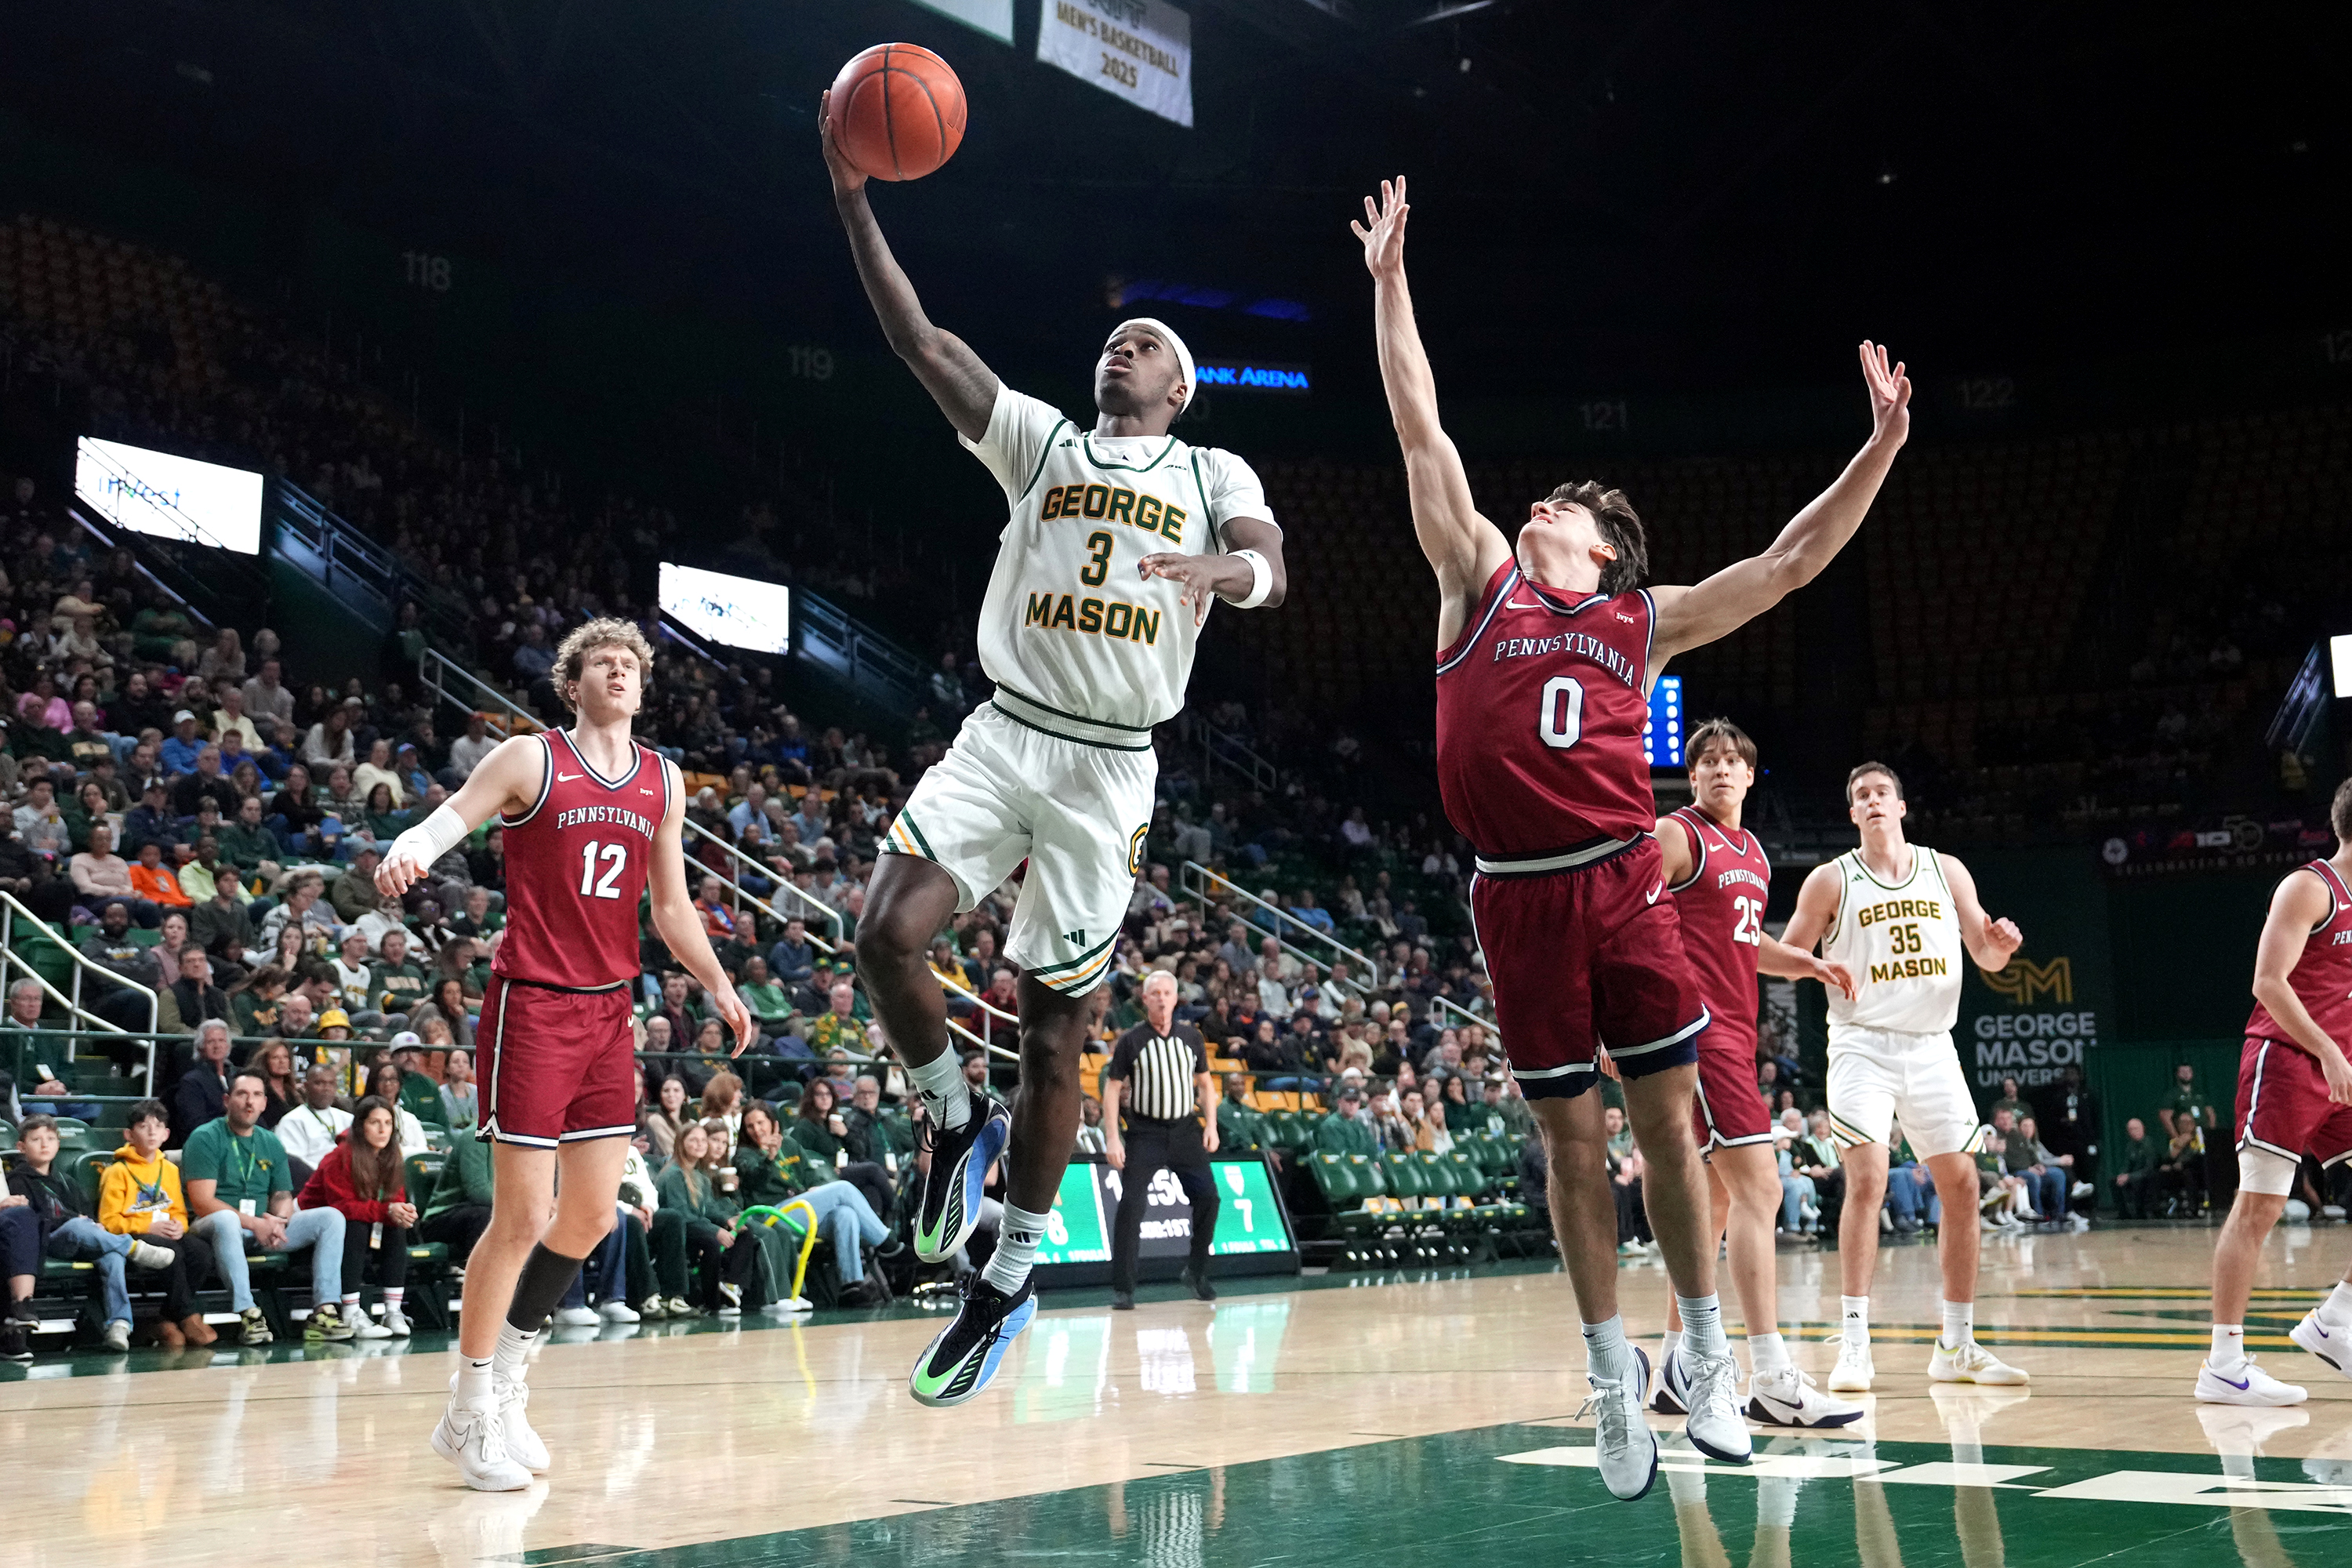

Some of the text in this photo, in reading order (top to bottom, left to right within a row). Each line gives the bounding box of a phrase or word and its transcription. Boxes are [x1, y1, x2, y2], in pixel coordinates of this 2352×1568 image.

[1057, 2, 1098, 37] MEN'S
[1101, 21, 1179, 78] BASKETBALL
[1102, 52, 1138, 88] 2025
[401, 250, 452, 292] 118
[788, 345, 834, 381] 119
[1195, 366, 1309, 389] ANK ARENA
[1578, 400, 1628, 431] 121
[1040, 483, 1187, 545] GEORGE
[1080, 531, 1114, 587] 3
[1024, 592, 1161, 646] MASON
[1493, 632, 1635, 687] PENNSYLVANIA
[1539, 675, 1584, 749] 0
[557, 806, 655, 841] PENNSYLVANIA
[579, 839, 627, 899] 12
[1718, 869, 1769, 900] PENNSYLVAN
[1733, 895, 1763, 947] 25
[1858, 899, 1942, 928] GEORGE
[1889, 923, 1922, 955] 35
[2332, 929, 2352, 946] PEN
[1870, 956, 1947, 984] MASON
[1974, 1011, 2096, 1040] GEORGE
[1233, 1198, 1254, 1232] 7
